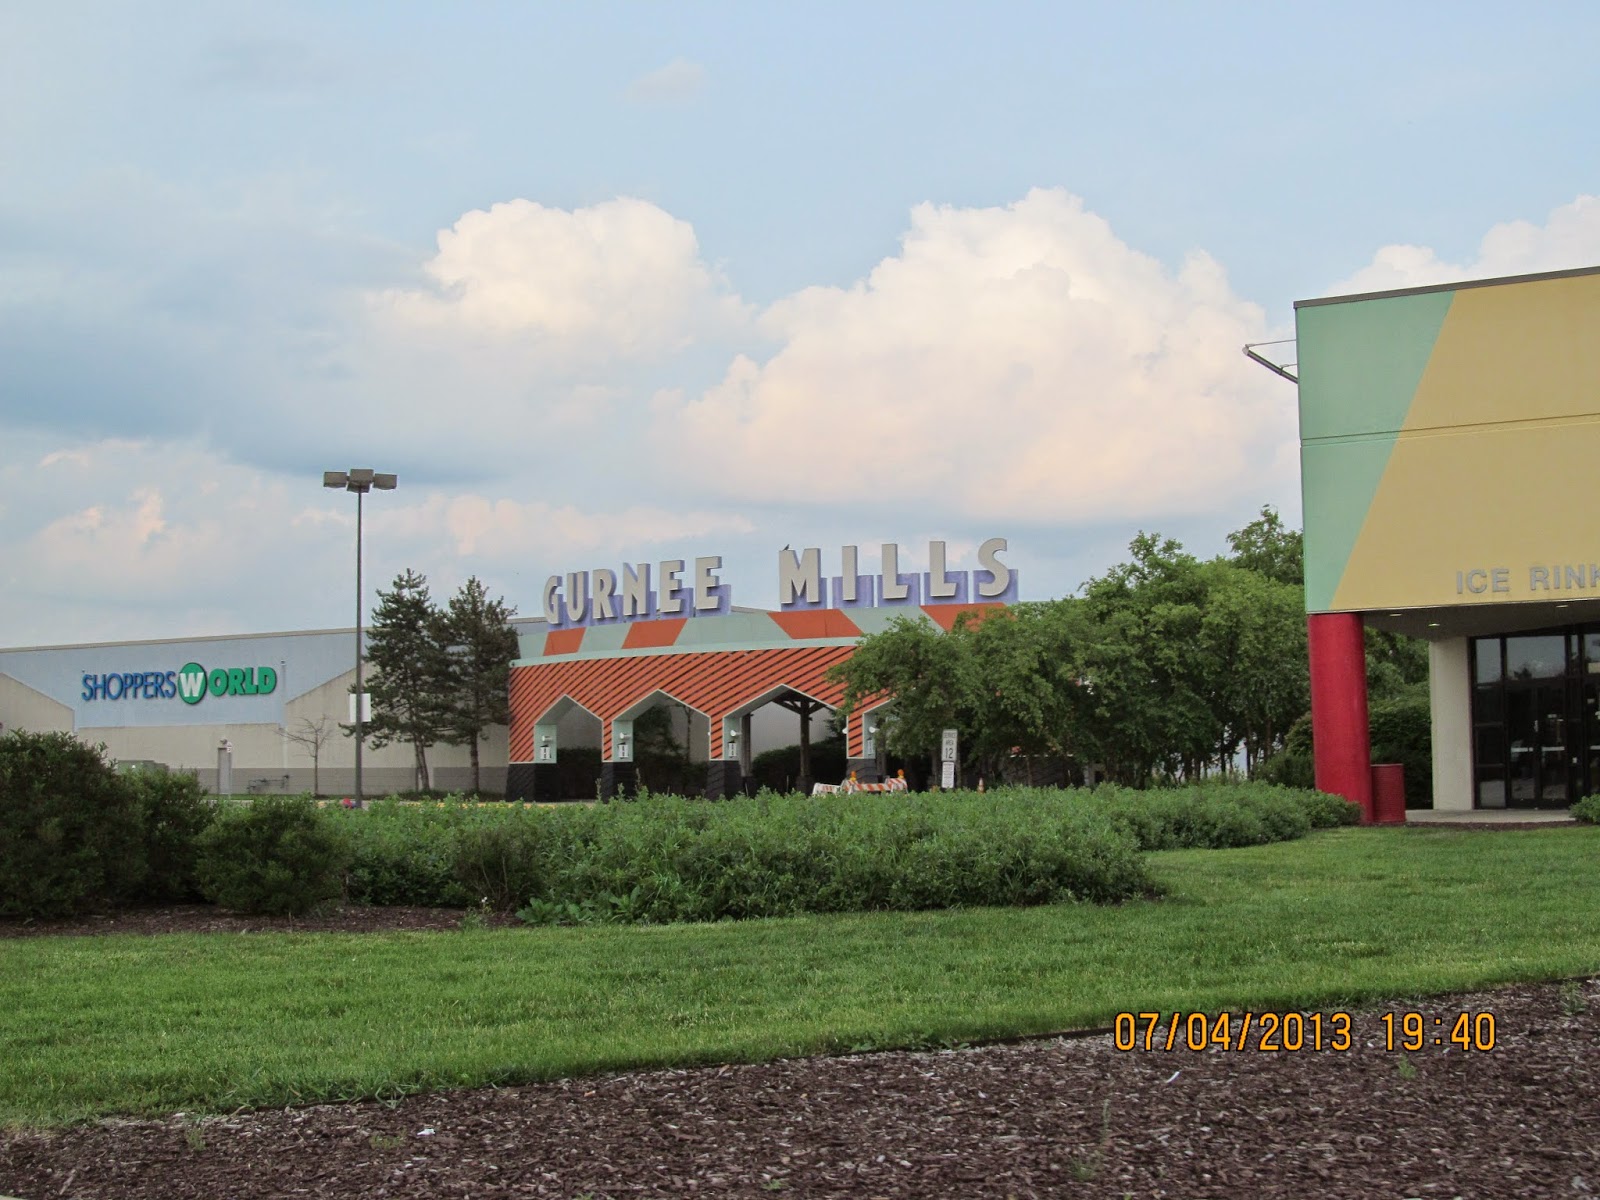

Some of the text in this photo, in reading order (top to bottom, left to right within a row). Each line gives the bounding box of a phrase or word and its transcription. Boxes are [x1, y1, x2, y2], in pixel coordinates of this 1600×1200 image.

[543, 538, 1011, 625] GURNEE MILLS
[1456, 568, 1510, 594] ICE
[82, 671, 177, 701] SHOPPERS
[945, 747, 954, 759] 12
